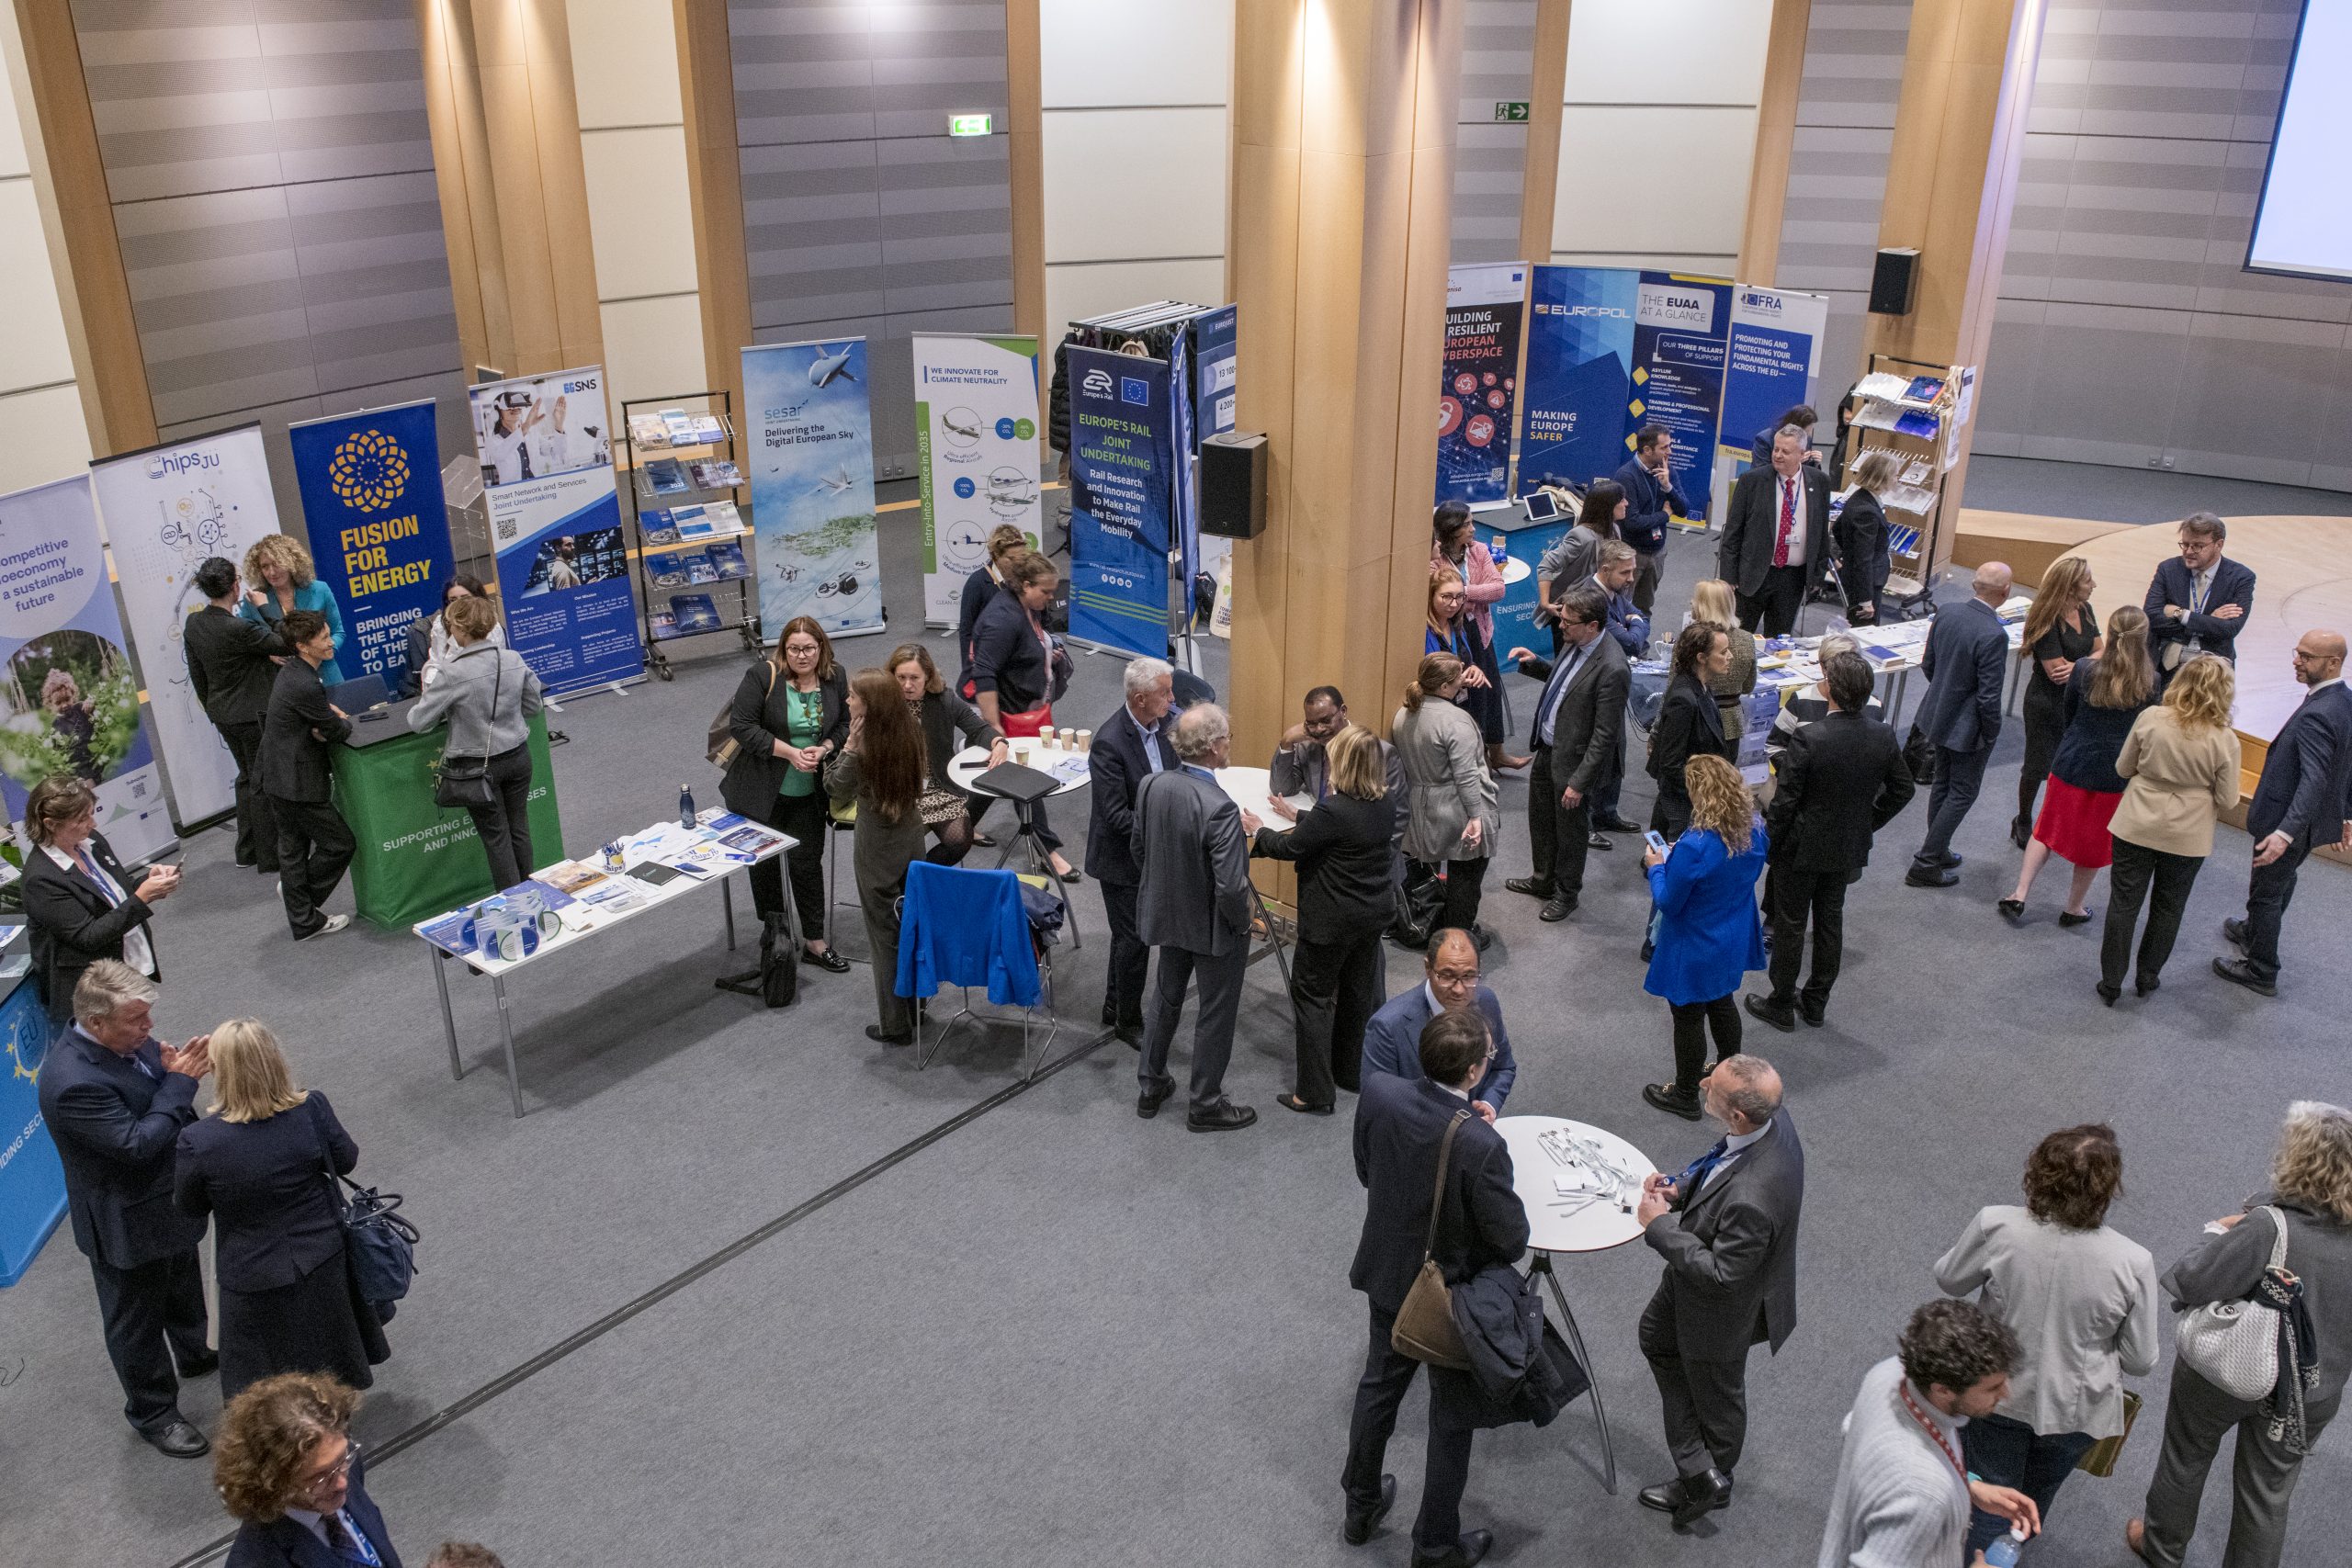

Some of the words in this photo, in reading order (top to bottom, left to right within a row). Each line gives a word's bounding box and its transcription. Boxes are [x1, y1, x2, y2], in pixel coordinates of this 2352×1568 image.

[1642, 294, 1664, 306] THE
[1667, 297, 1699, 310] EUAA
[1758, 295, 1781, 310] FRA
[1446, 311, 1492, 324] UILDING
[1551, 305, 1631, 318] EUROPOL
[1640, 307, 1653, 316] AT
[1655, 309, 1662, 317] A
[1665, 310, 1707, 322] GLANCE
[1215, 318, 1234, 330] EUROJUST
[1447, 322, 1502, 337] RESILIENT
[1444, 335, 1495, 349] UROPEAN
[1698, 345, 1724, 354] PILLARS
[1735, 334, 1773, 347] PROMOTING
[1774, 341, 1788, 350] AND
[1443, 347, 1503, 361] YBERSPACE
[1695, 353, 1722, 361] SUPPORT
[1734, 343, 1772, 356] PROTECTING
[1773, 350, 1791, 359] YOUR
[1732, 362, 1756, 372] ACROSS
[1733, 353, 1780, 367] FUNDAMENTAL
[1781, 361, 1804, 372] RIGHTS
[1219, 368, 1225, 378] 13
[1083, 389, 1104, 399] Europe's
[765, 406, 801, 419] sesar
[1532, 410, 1577, 421] MAKING
[1648, 405, 1682, 414] DEVELOPMENT
[1675, 403, 1710, 412] PROFESSIONAL
[765, 426, 809, 437] Delivering
[1079, 414, 1128, 431] EUROPE'S
[1131, 423, 1152, 437] RAIL
[1531, 421, 1573, 431] EUROPE
[766, 436, 793, 447] Digital
[796, 432, 837, 443] European
[838, 431, 854, 440] Sky
[919, 431, 929, 452] 2035
[1102, 435, 1131, 450] JOINT
[1530, 431, 1562, 441] SAFER
[202, 454, 220, 469] JU
[921, 456, 930, 464] in
[1081, 447, 1150, 470] UNDERTAKING
[1090, 469, 1105, 479] Rail
[1107, 473, 1142, 488] Research
[492, 491, 513, 501] Smart
[514, 486, 542, 498] Network
[543, 483, 556, 492] and
[558, 478, 587, 488] Services
[1087, 483, 1102, 492] and
[1104, 485, 1145, 502] Innovation
[493, 501, 512, 510] Joint
[514, 492, 557, 506] Undertaking
[922, 468, 933, 547] Entry-Into-Service
[1093, 496, 1101, 505] to
[1103, 497, 1123, 510] Make
[1125, 502, 1141, 514] Rail
[1091, 508, 1104, 518] the
[1106, 512, 1142, 529] Everyday
[340, 514, 419, 552] FUSION
[1101, 524, 1133, 539] Mobility
[0, 539, 69, 567] ompetitive
[344, 546, 389, 575] FOR
[0, 556, 66, 585] oeconomy
[349, 559, 431, 598] ENERGY
[3, 591, 11, 600] a
[13, 567, 84, 596] sustainable
[15, 593, 55, 612] future
[1497, 601, 1536, 614] ENSURING
[356, 608, 422, 634] BRINGING
[1516, 612, 1531, 621] SEC
[358, 631, 386, 647] THE
[389, 626, 410, 639] PO
[361, 647, 379, 660] OF
[382, 639, 408, 654] THE
[362, 660, 383, 674] TO
[387, 654, 406, 668] EA
[526, 786, 547, 801] SES
[383, 819, 460, 852] SUPPORTING
[424, 837, 449, 853] AND
[451, 827, 478, 844] INNO
[20, 1017, 39, 1050] EU
